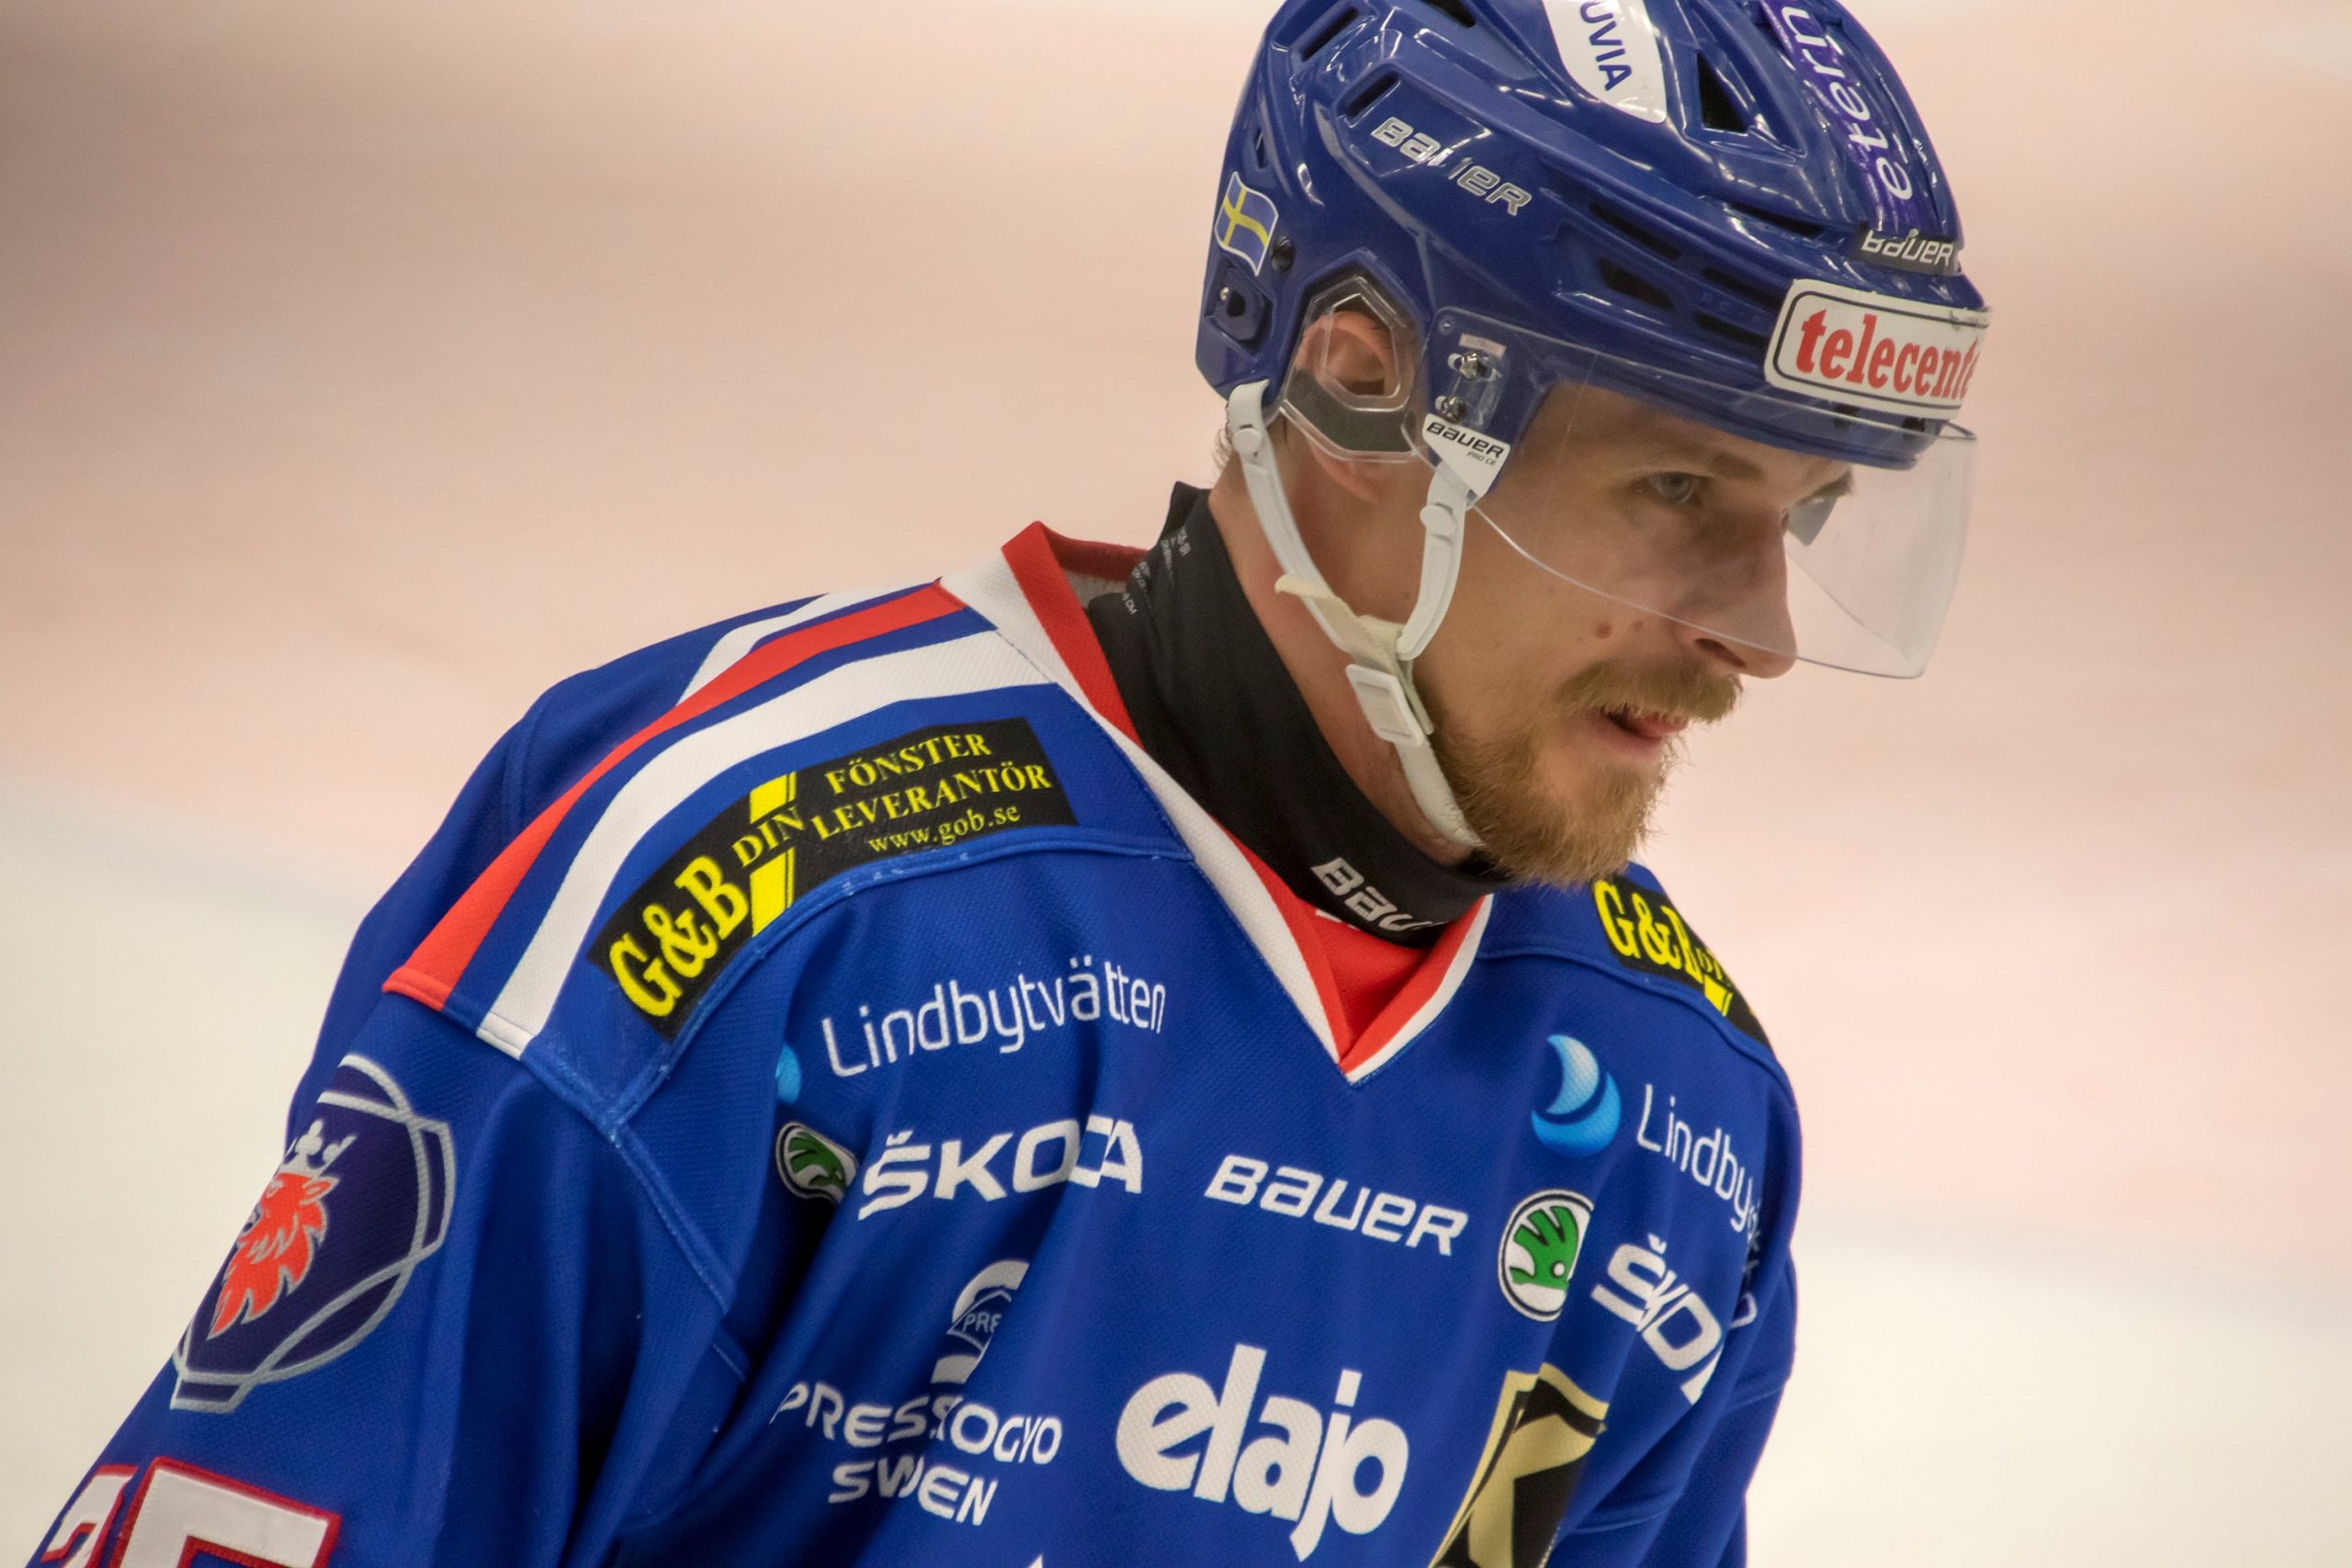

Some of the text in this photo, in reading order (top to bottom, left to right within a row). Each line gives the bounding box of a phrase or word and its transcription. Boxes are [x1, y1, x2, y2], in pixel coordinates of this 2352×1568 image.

[1579, 0, 1632, 91] UVIA
[1781, 6, 1913, 200] etern
[1796, 309, 1980, 400] telecent
[1426, 422, 1504, 458] BAUER
[810, 761, 1053, 840] LEVERANTÖR
[825, 734, 992, 795] FÖNSTER
[731, 807, 805, 868] DIN
[868, 805, 1022, 853] www.gob.se
[609, 855, 749, 1017] G&B
[1310, 857, 1433, 931] BAU
[821, 954, 1166, 1077] Lindbytvätten
[1204, 1155, 1469, 1257] BAUER
[963, 1311, 1003, 1334] PRE
[1115, 1343, 1408, 1562] elajo
